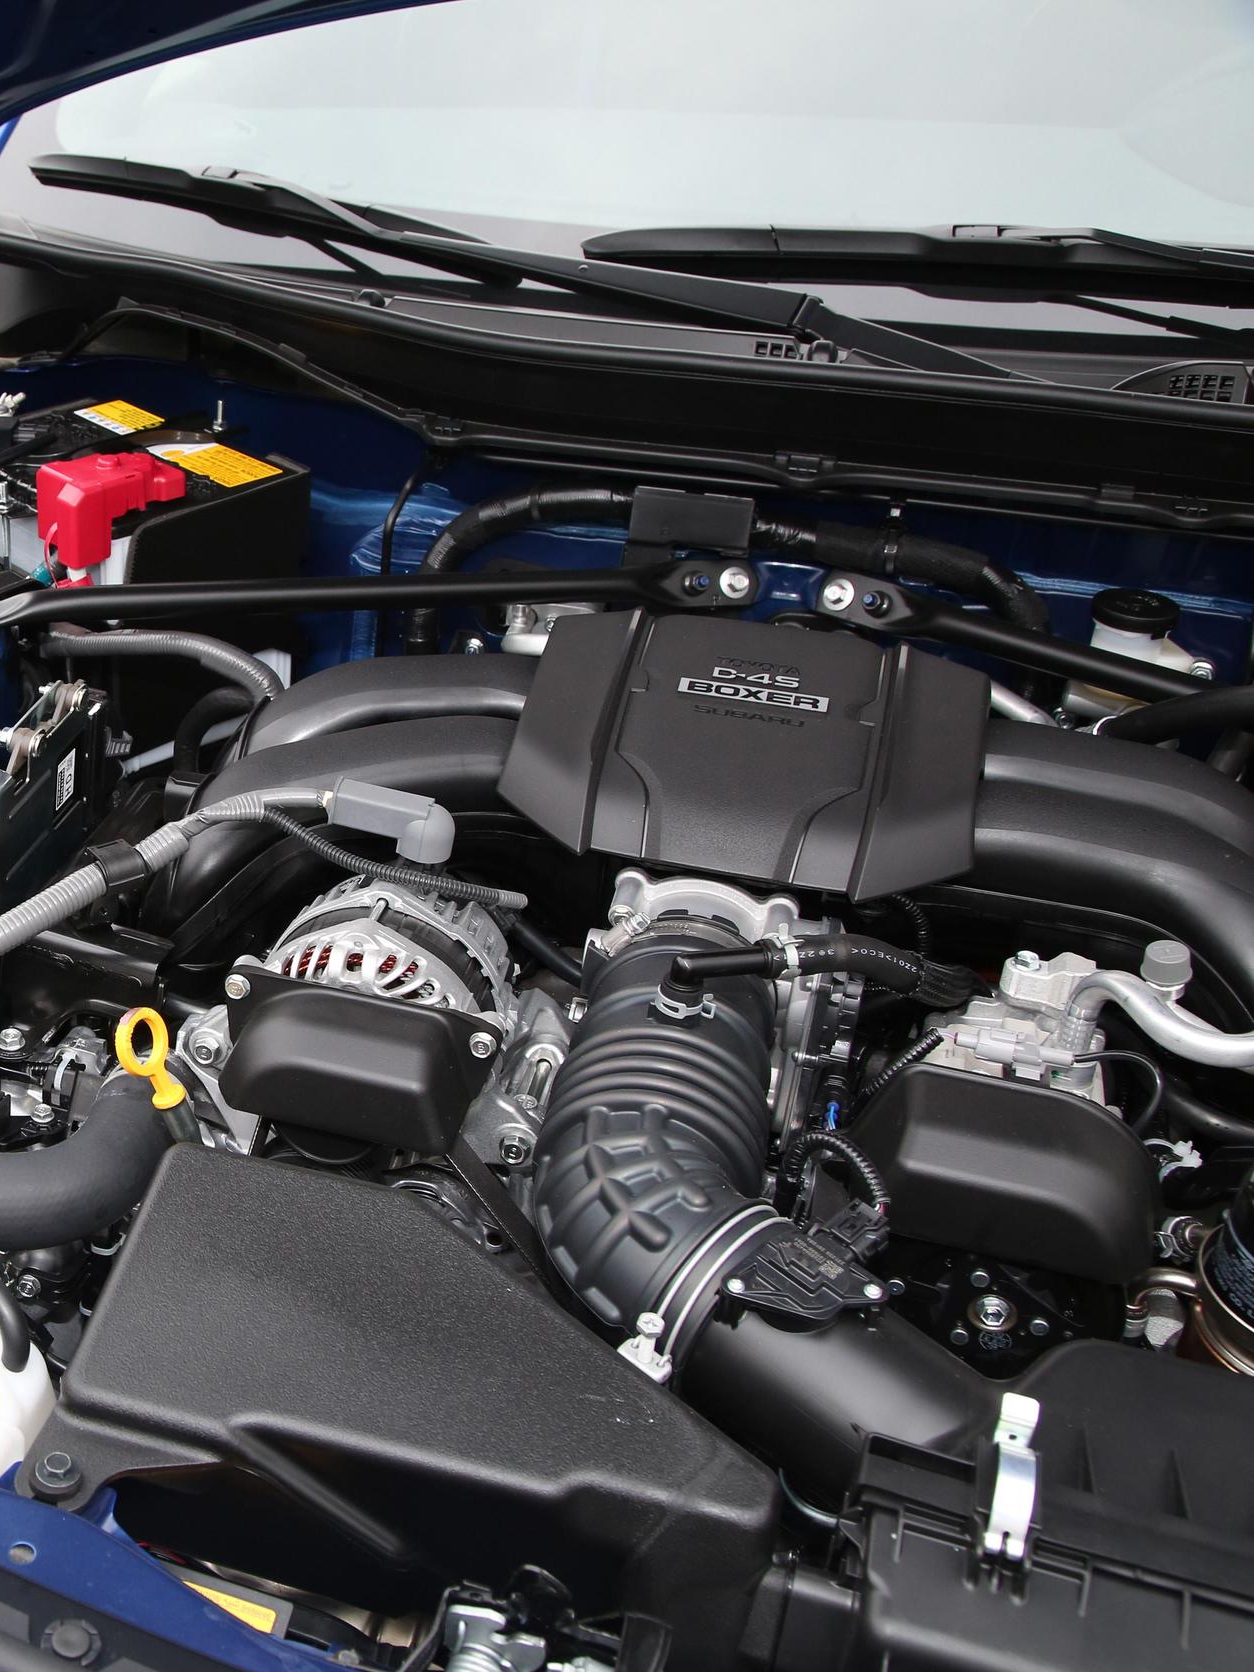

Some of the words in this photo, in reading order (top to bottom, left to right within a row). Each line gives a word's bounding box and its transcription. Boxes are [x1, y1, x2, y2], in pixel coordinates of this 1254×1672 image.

[712, 666, 801, 689] D-4S
[716, 656, 801, 676] TOYOTA
[686, 680, 821, 710] BOXER
[693, 704, 805, 729] SUBARU
